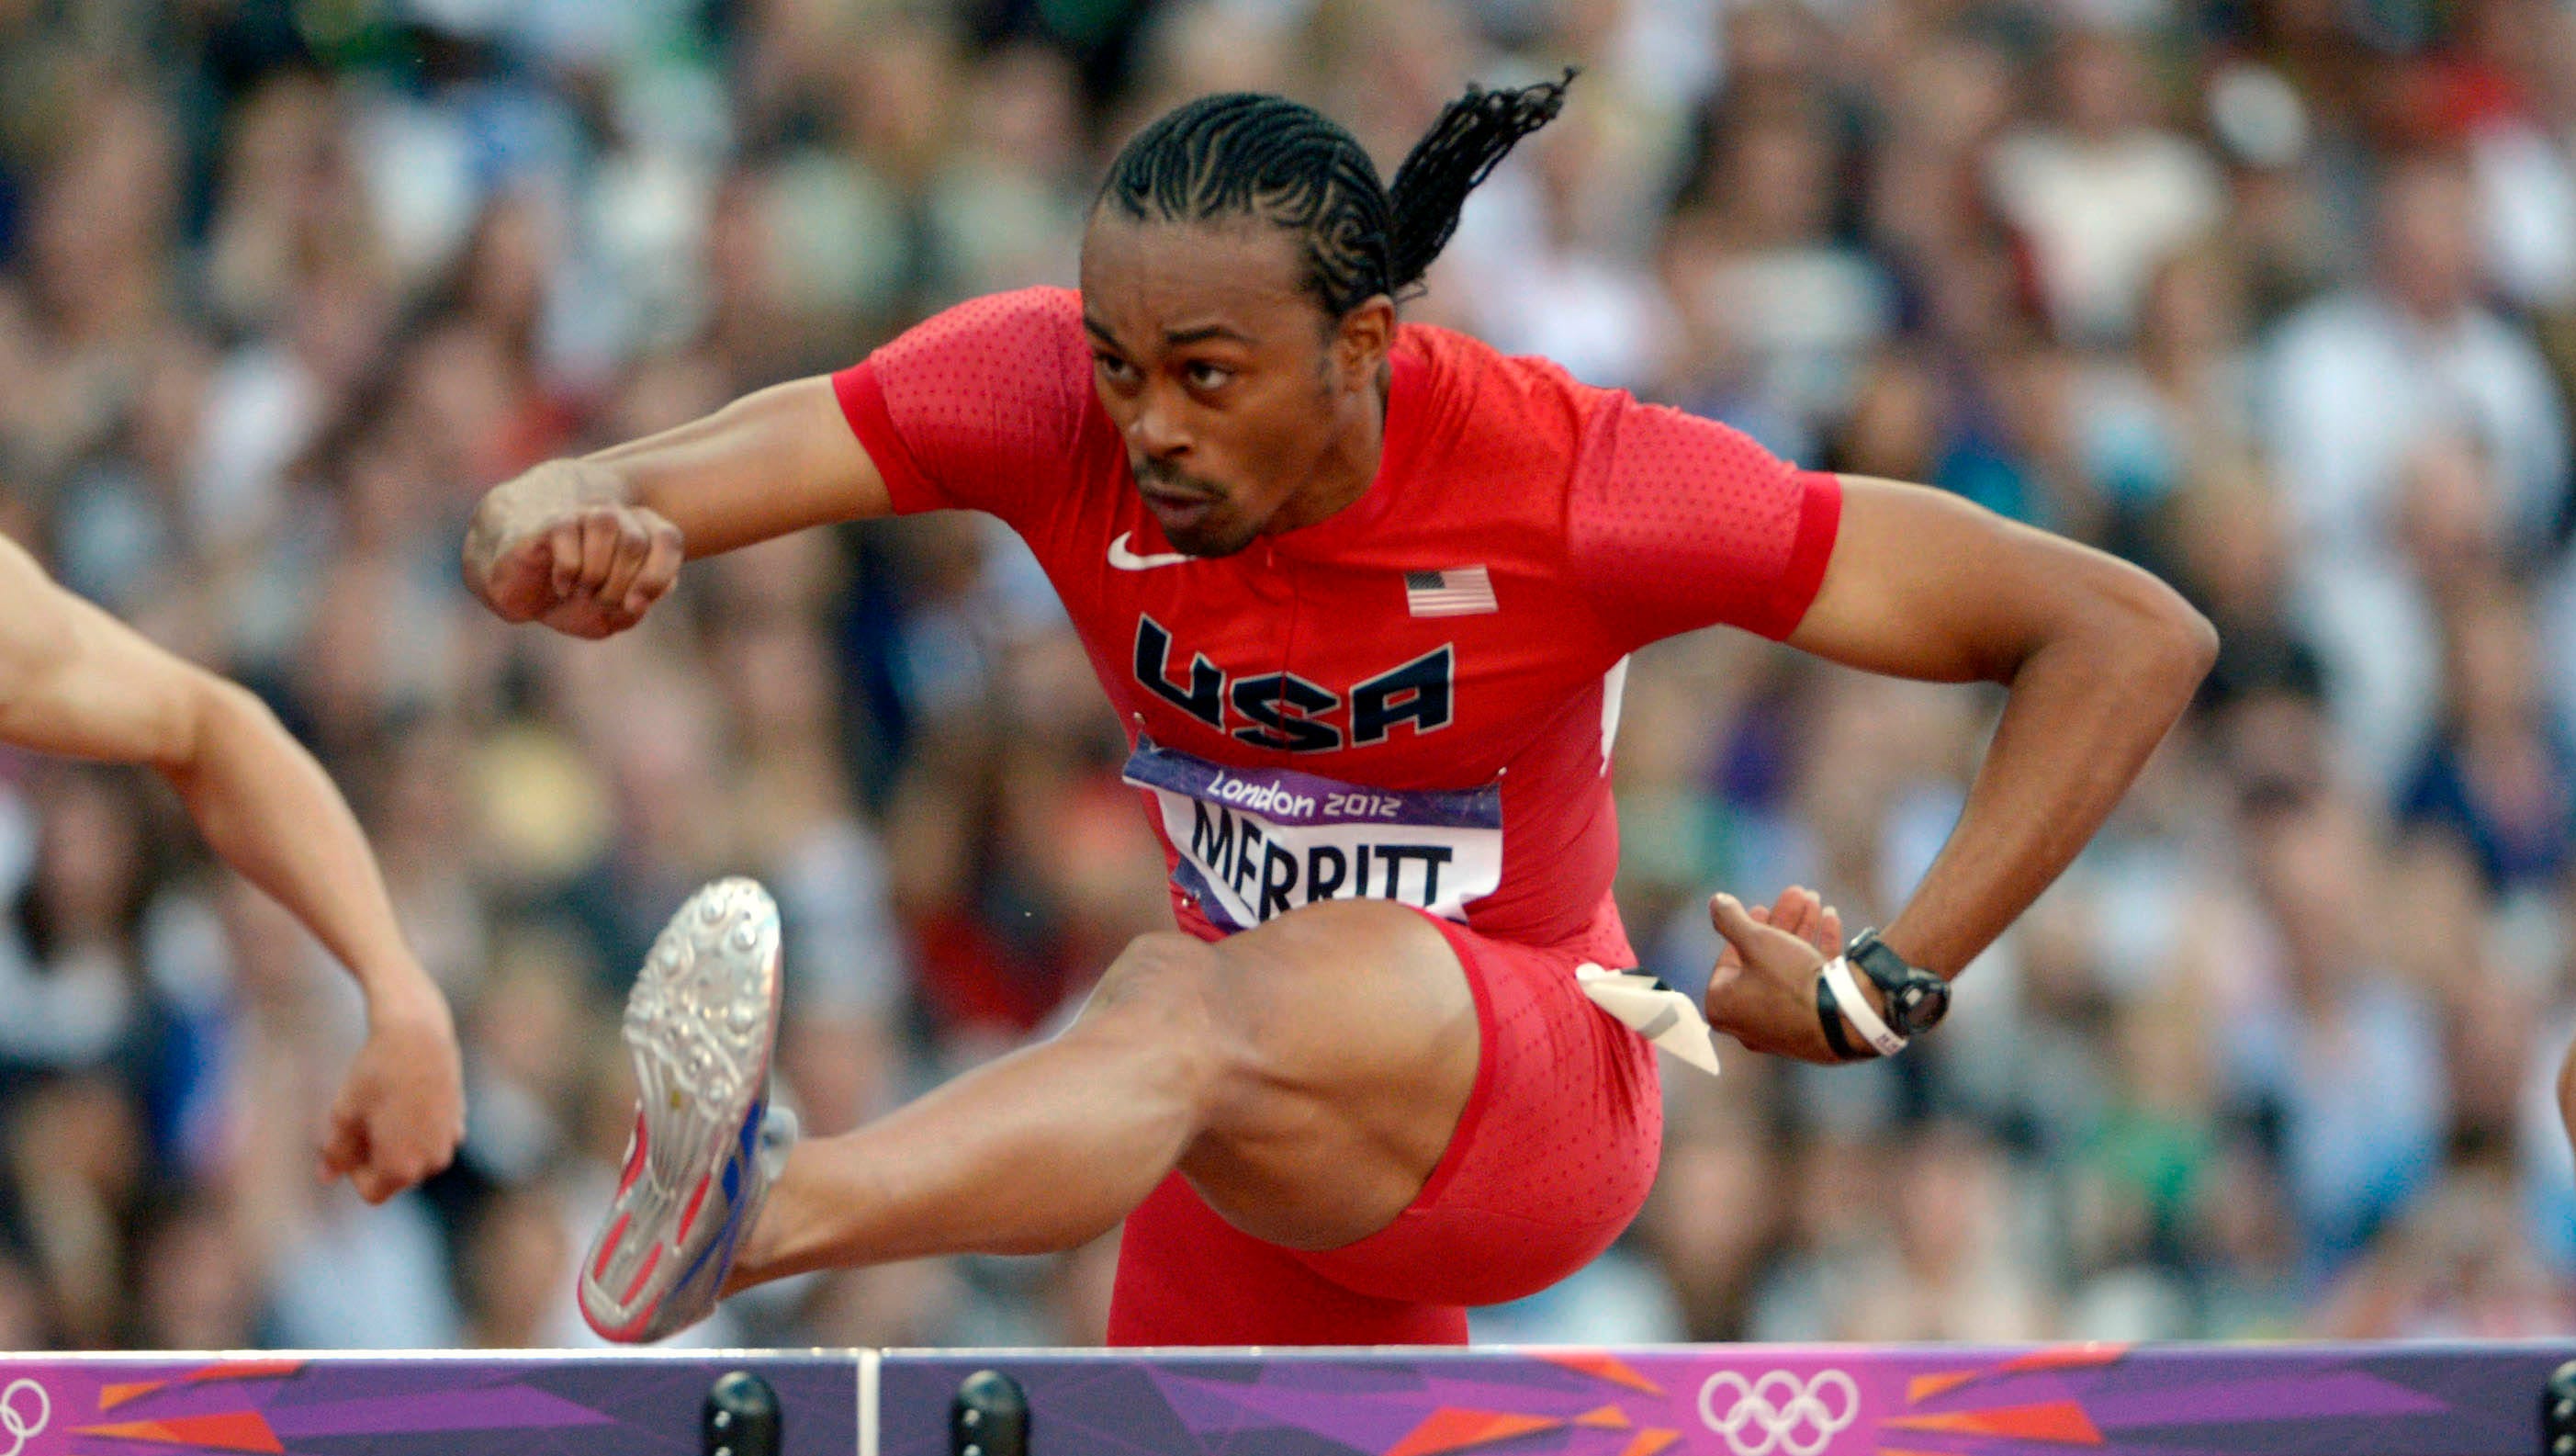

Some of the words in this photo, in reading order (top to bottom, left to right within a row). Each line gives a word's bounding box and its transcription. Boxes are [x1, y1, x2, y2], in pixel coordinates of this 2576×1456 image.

[1133, 612, 1454, 754] USA
[1207, 770, 1315, 818] London
[1322, 793, 1401, 817] 2012
[1192, 800, 1453, 922] MERRITT
